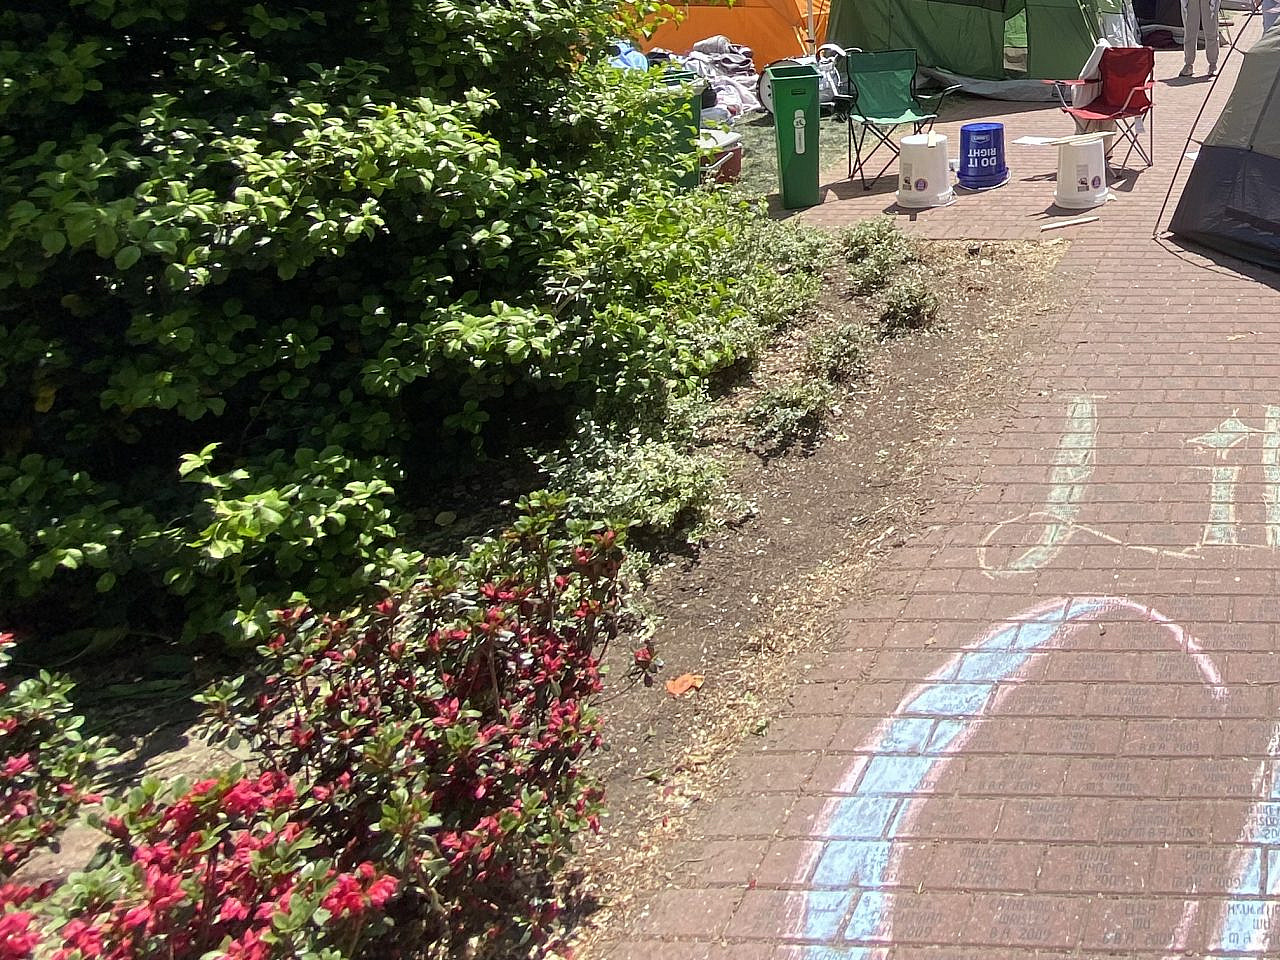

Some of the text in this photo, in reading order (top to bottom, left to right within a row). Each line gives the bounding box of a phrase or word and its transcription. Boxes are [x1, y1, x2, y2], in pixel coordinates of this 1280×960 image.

[968, 147, 997, 157] RIGHT
[968, 157, 997, 168] DO IT
